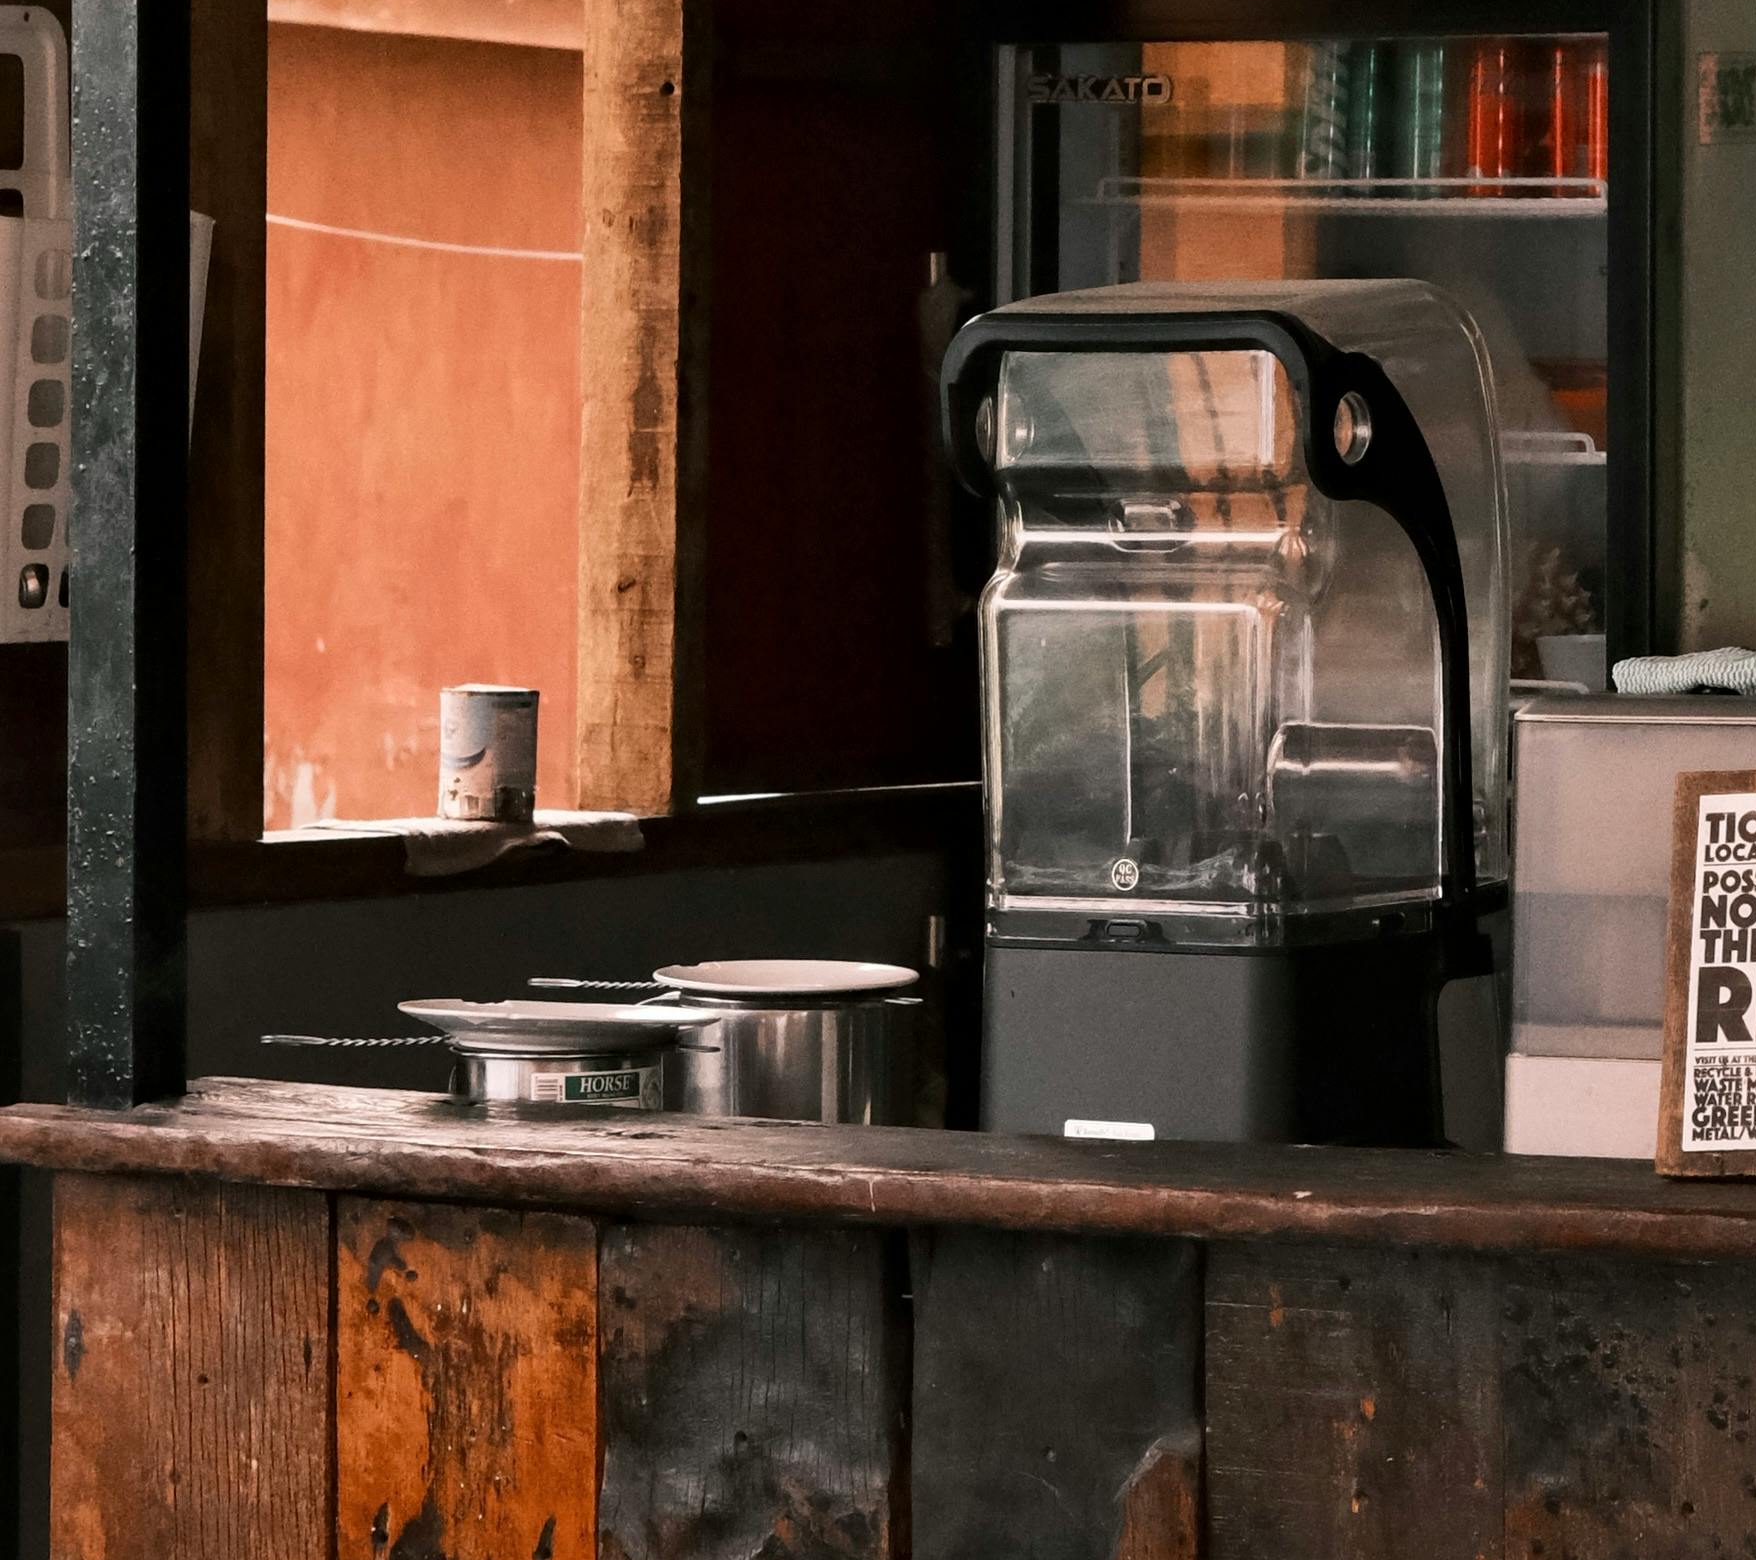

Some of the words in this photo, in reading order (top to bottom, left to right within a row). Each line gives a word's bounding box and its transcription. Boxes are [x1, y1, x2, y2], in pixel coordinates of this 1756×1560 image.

[1026, 73, 1174, 105] SAKATO
[1695, 1056, 1718, 1066] VISIT
[1731, 1055, 1742, 1065] AT
[1693, 1066, 1743, 1079] RECYCLE
[580, 1074, 632, 1094] HORSE
[1693, 1078, 1743, 1093] WASTE
[1693, 1092, 1743, 1107] WATER
